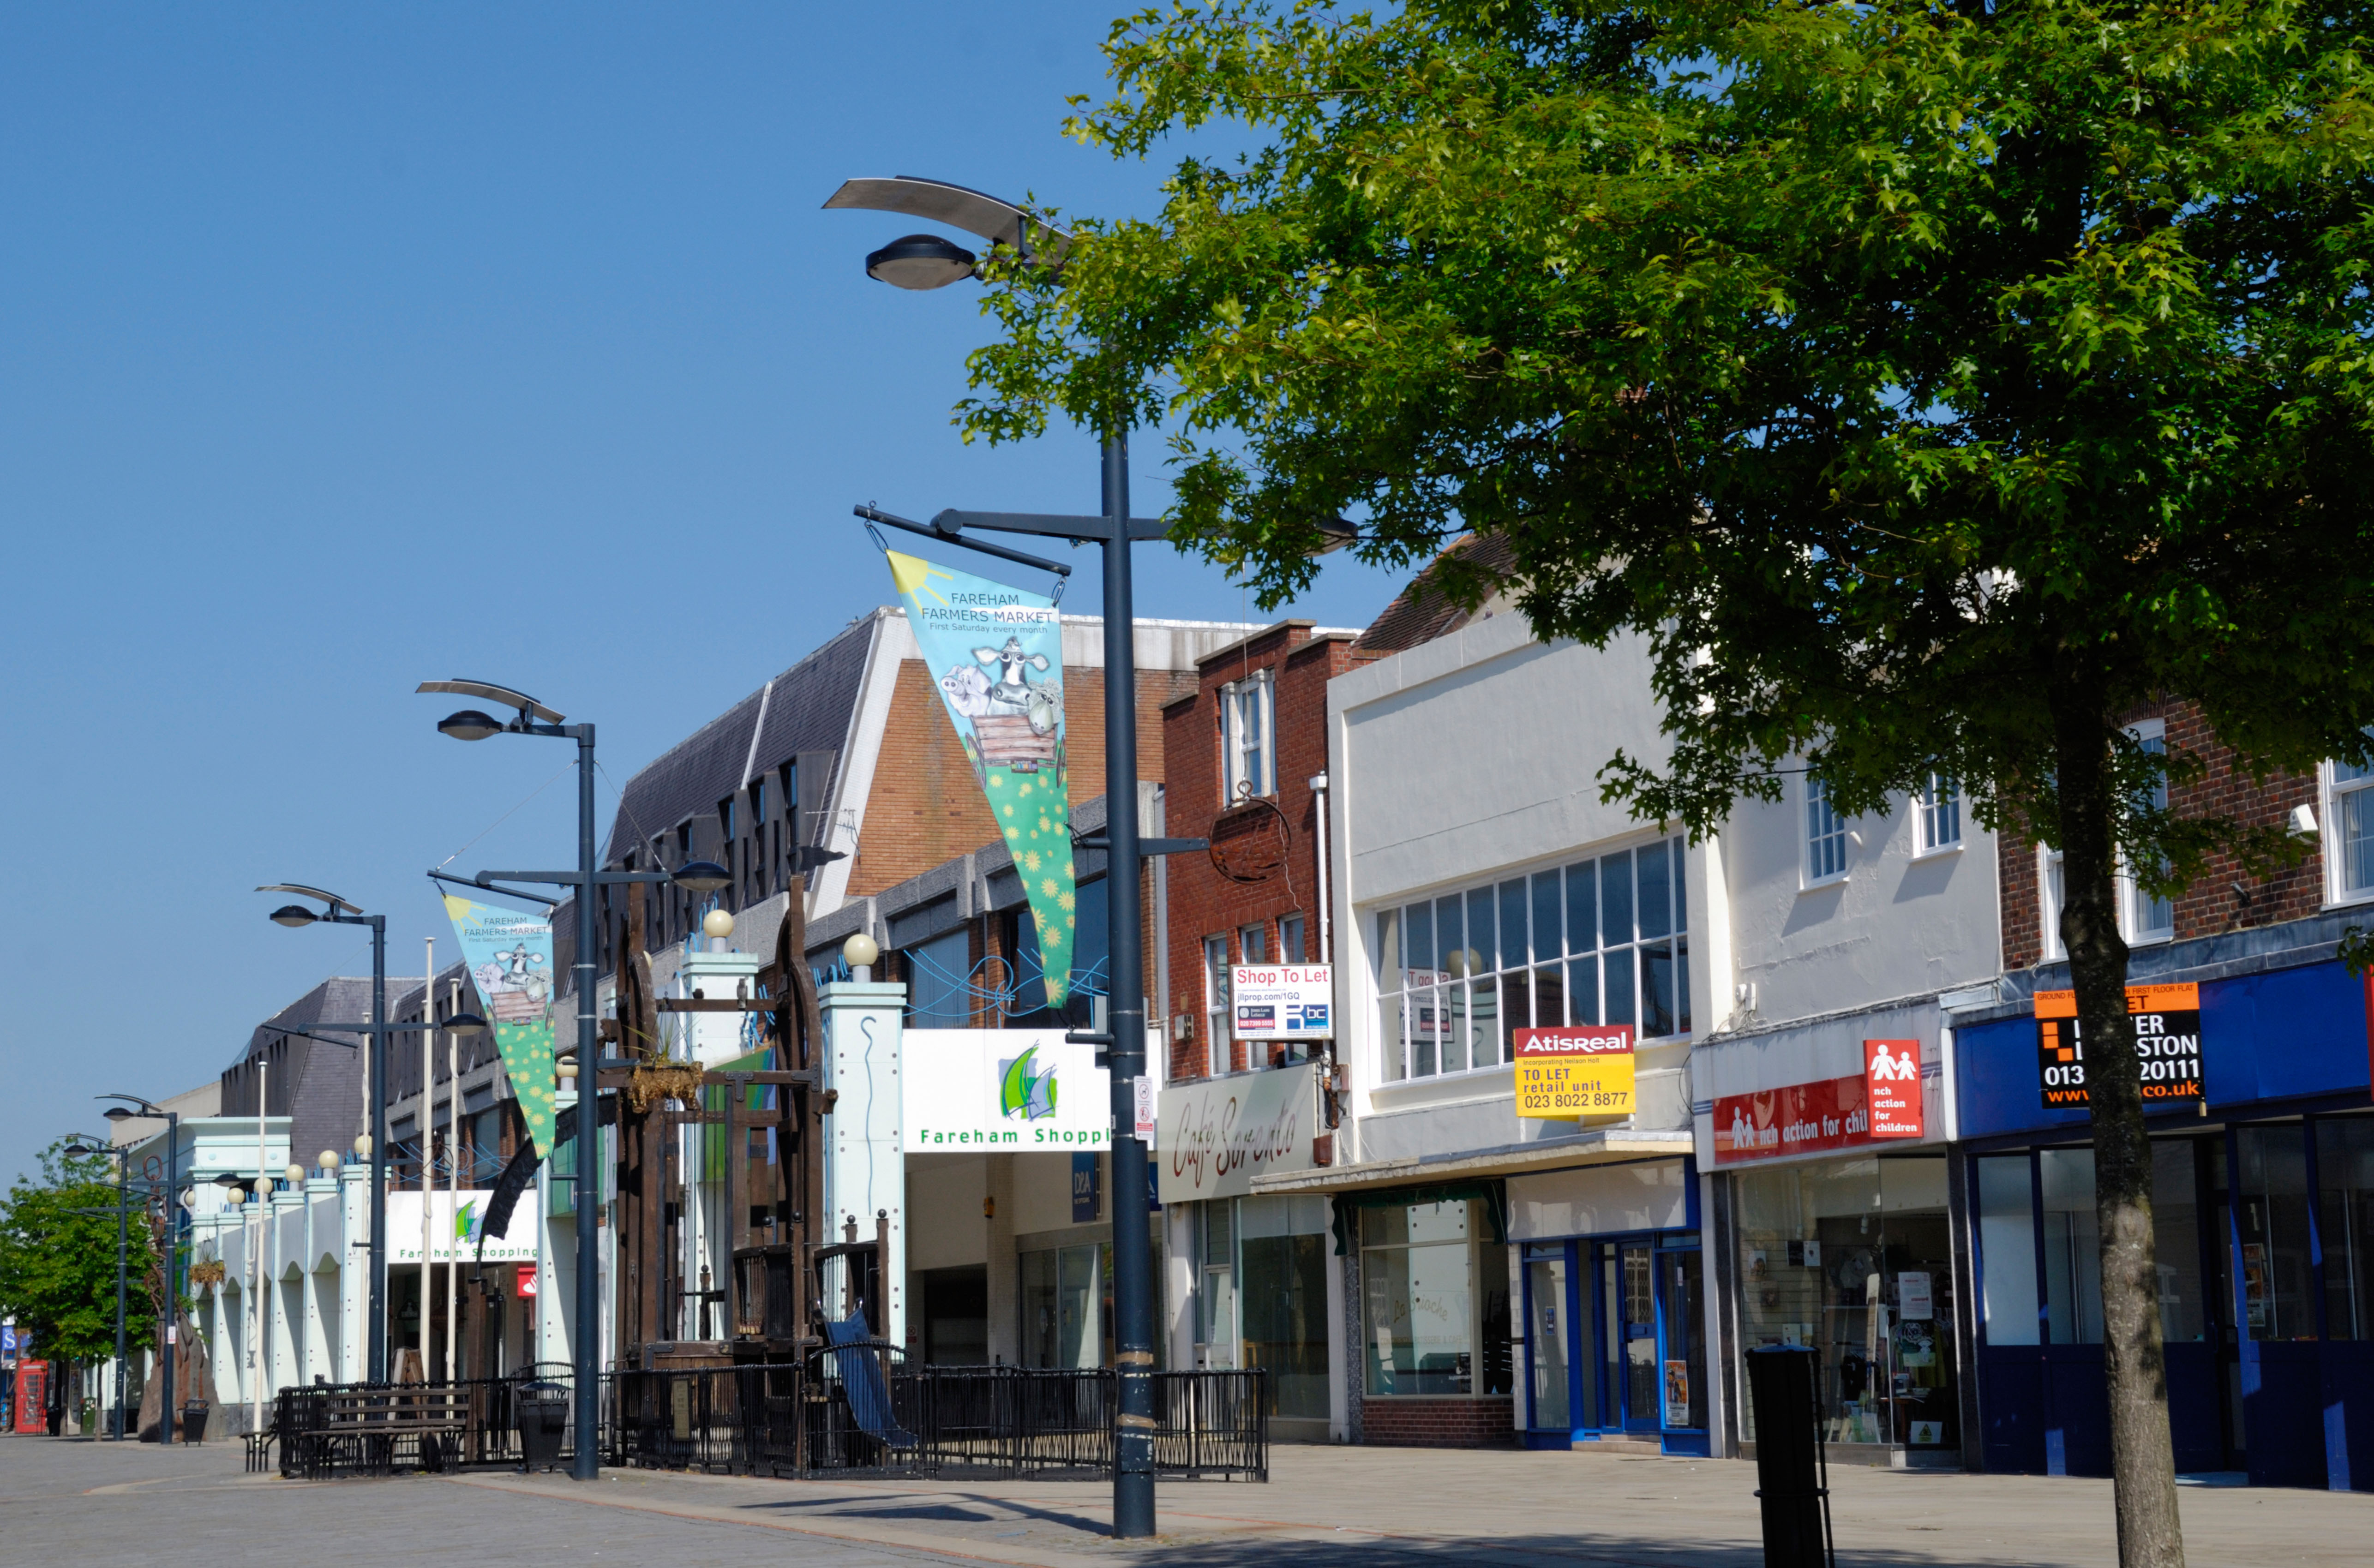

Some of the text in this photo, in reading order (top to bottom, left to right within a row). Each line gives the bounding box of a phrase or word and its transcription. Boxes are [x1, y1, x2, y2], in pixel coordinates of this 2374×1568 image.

[952, 593, 1019, 605] FAREHAM
[922, 608, 1052, 623] FARMERS MARKET
[952, 623, 989, 633] Saturday
[510, 927, 547, 935] MARKET
[1237, 968, 1328, 987] Shop To Let
[1237, 992, 1300, 1003] jllprop.com/1GQ
[2127, 995, 2148, 1010] ET
[1307, 1006, 1326, 1019] bc
[1523, 1058, 1563, 1066] Incorporating
[1523, 1068, 1570, 1081] TO LET
[1524, 1080, 1601, 1093] retail unit
[1874, 1086, 1892, 1095] nch
[1525, 1092, 1628, 1108] 023 8022 8877
[1875, 1099, 1906, 1108] action
[1875, 1111, 1890, 1120] for
[1760, 1109, 1867, 1146] nch action for chil
[1876, 1123, 1917, 1132] children
[921, 1128, 1110, 1144] Fareham Shoppi
[1174, 1090, 1215, 1188] Café
[401, 1249, 462, 1258] Farham
